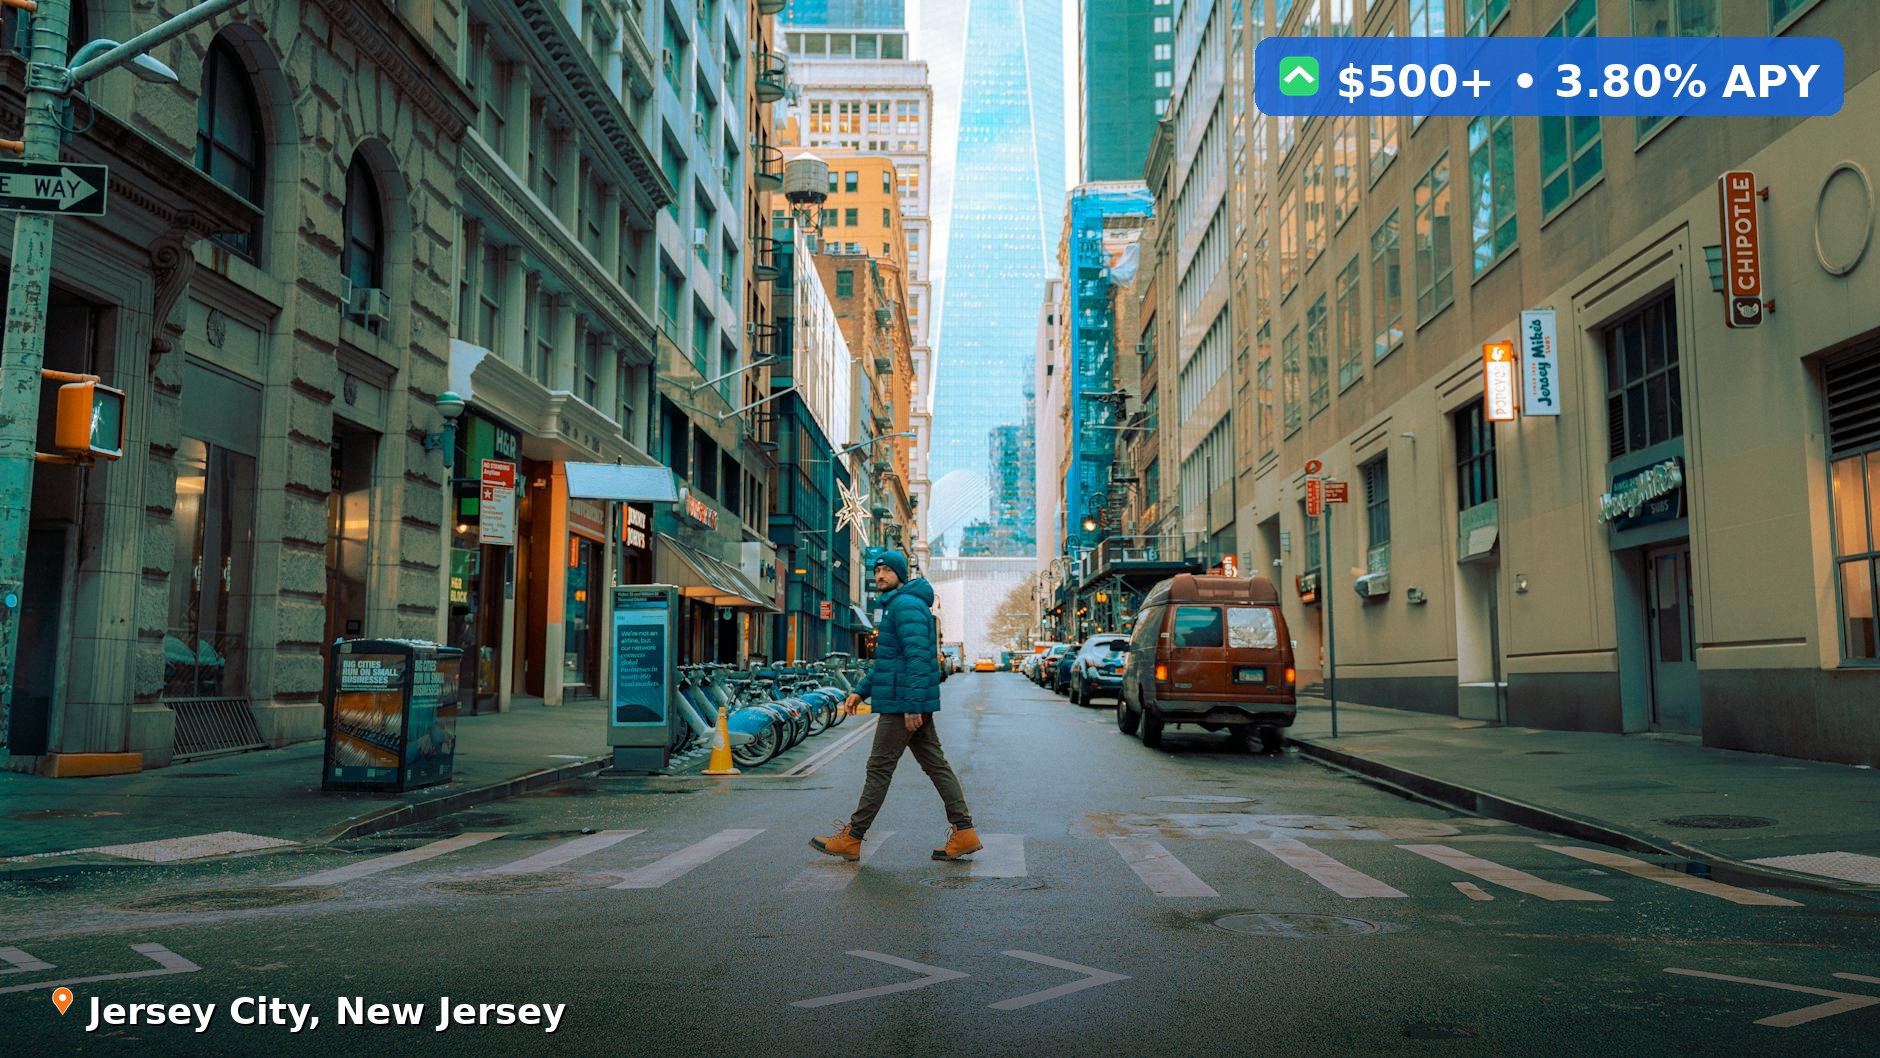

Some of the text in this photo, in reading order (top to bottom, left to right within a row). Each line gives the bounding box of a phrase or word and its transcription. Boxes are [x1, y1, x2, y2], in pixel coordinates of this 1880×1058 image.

[34, 178, 81, 198] WAY
[1733, 178, 1755, 290] CHIPOTLE
[1529, 319, 1552, 406] Jersey Mike's
[496, 428, 517, 460] H&R
[1599, 489, 1641, 524] Jersey
[342, 668, 398, 677] RUN ON SMALL
[343, 660, 381, 669] BIG CITIES
[342, 676, 389, 684] BUSINESSES
